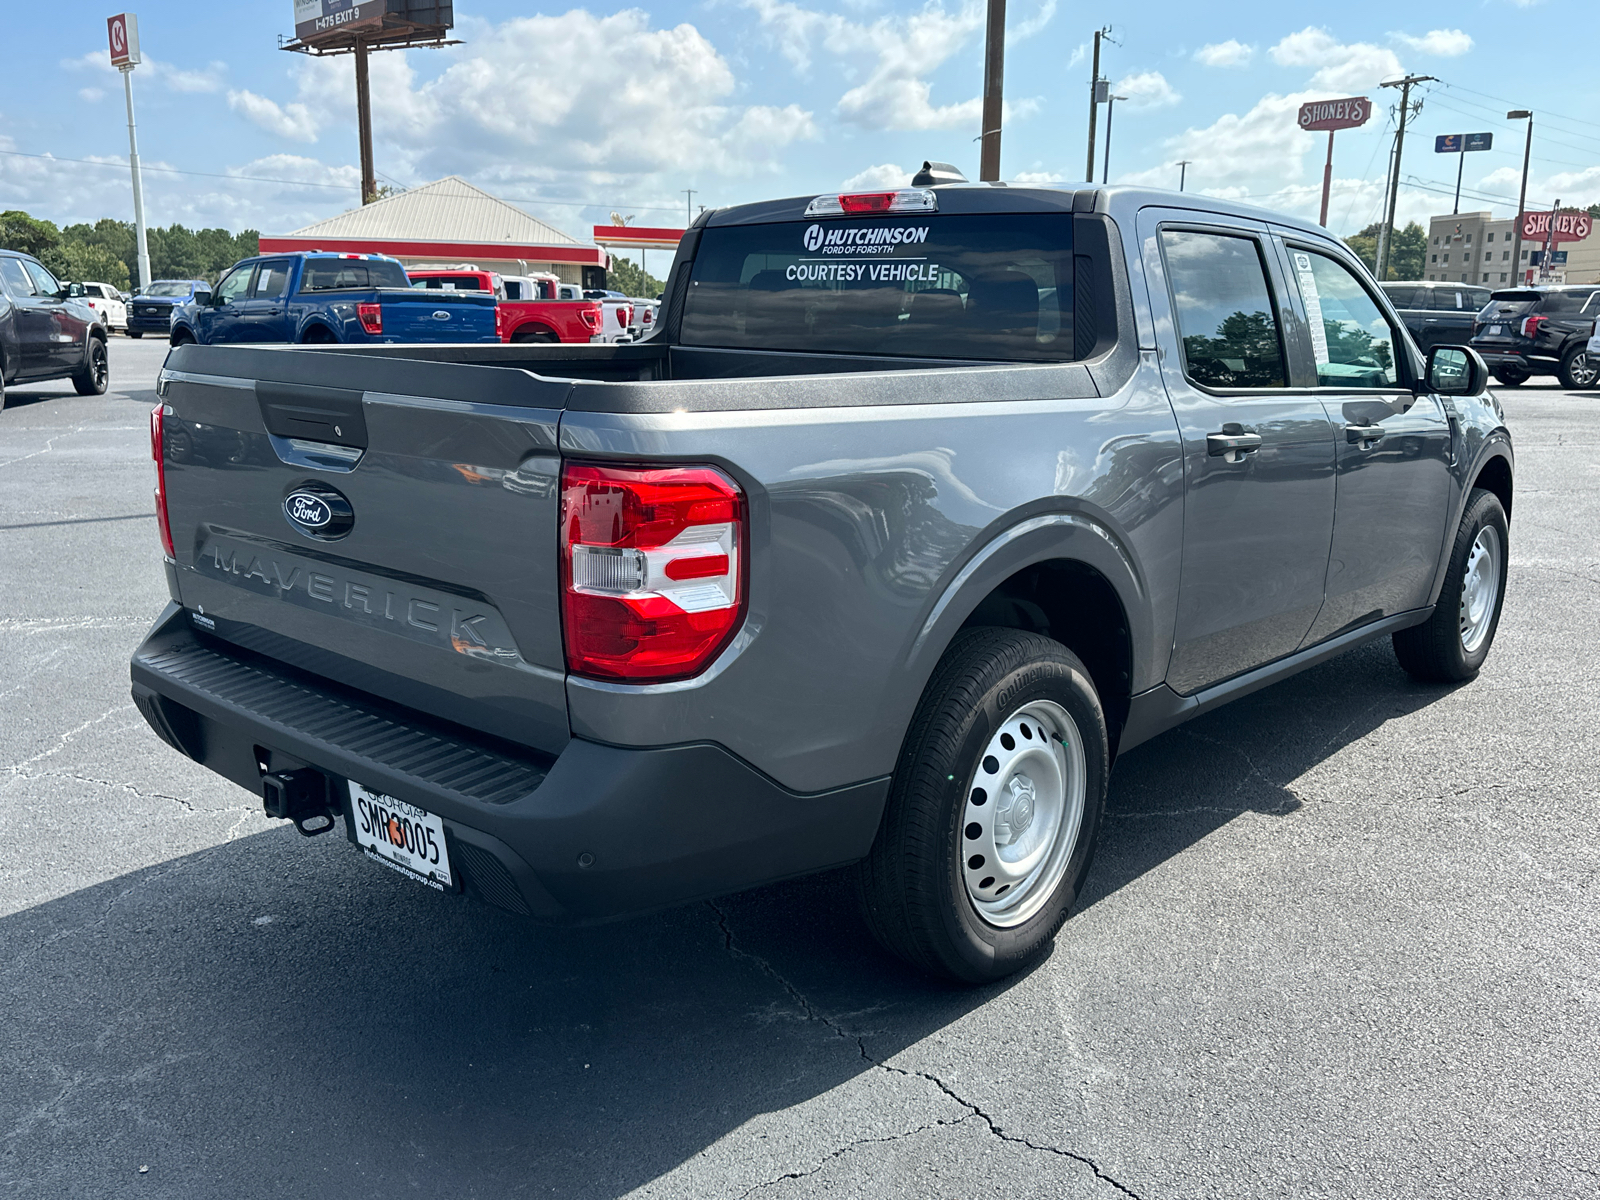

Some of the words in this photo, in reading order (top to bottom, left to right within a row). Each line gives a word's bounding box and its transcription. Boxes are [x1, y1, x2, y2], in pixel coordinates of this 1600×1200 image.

[315, 15, 334, 31] I-475
[335, 8, 353, 25] EXIT
[354, 7, 360, 19] 9
[1301, 100, 1363, 126] SHONEY'S
[824, 226, 930, 246] HUTCHINSON
[822, 246, 844, 255] FORD
[844, 246, 856, 254] OF
[856, 245, 895, 254] FORSYTH
[785, 264, 867, 281] COURTESY
[869, 264, 940, 281] VEHICLE
[293, 497, 322, 522] Ford
[213, 546, 488, 646] MAVERICK
[358, 797, 440, 865] SMR3005
